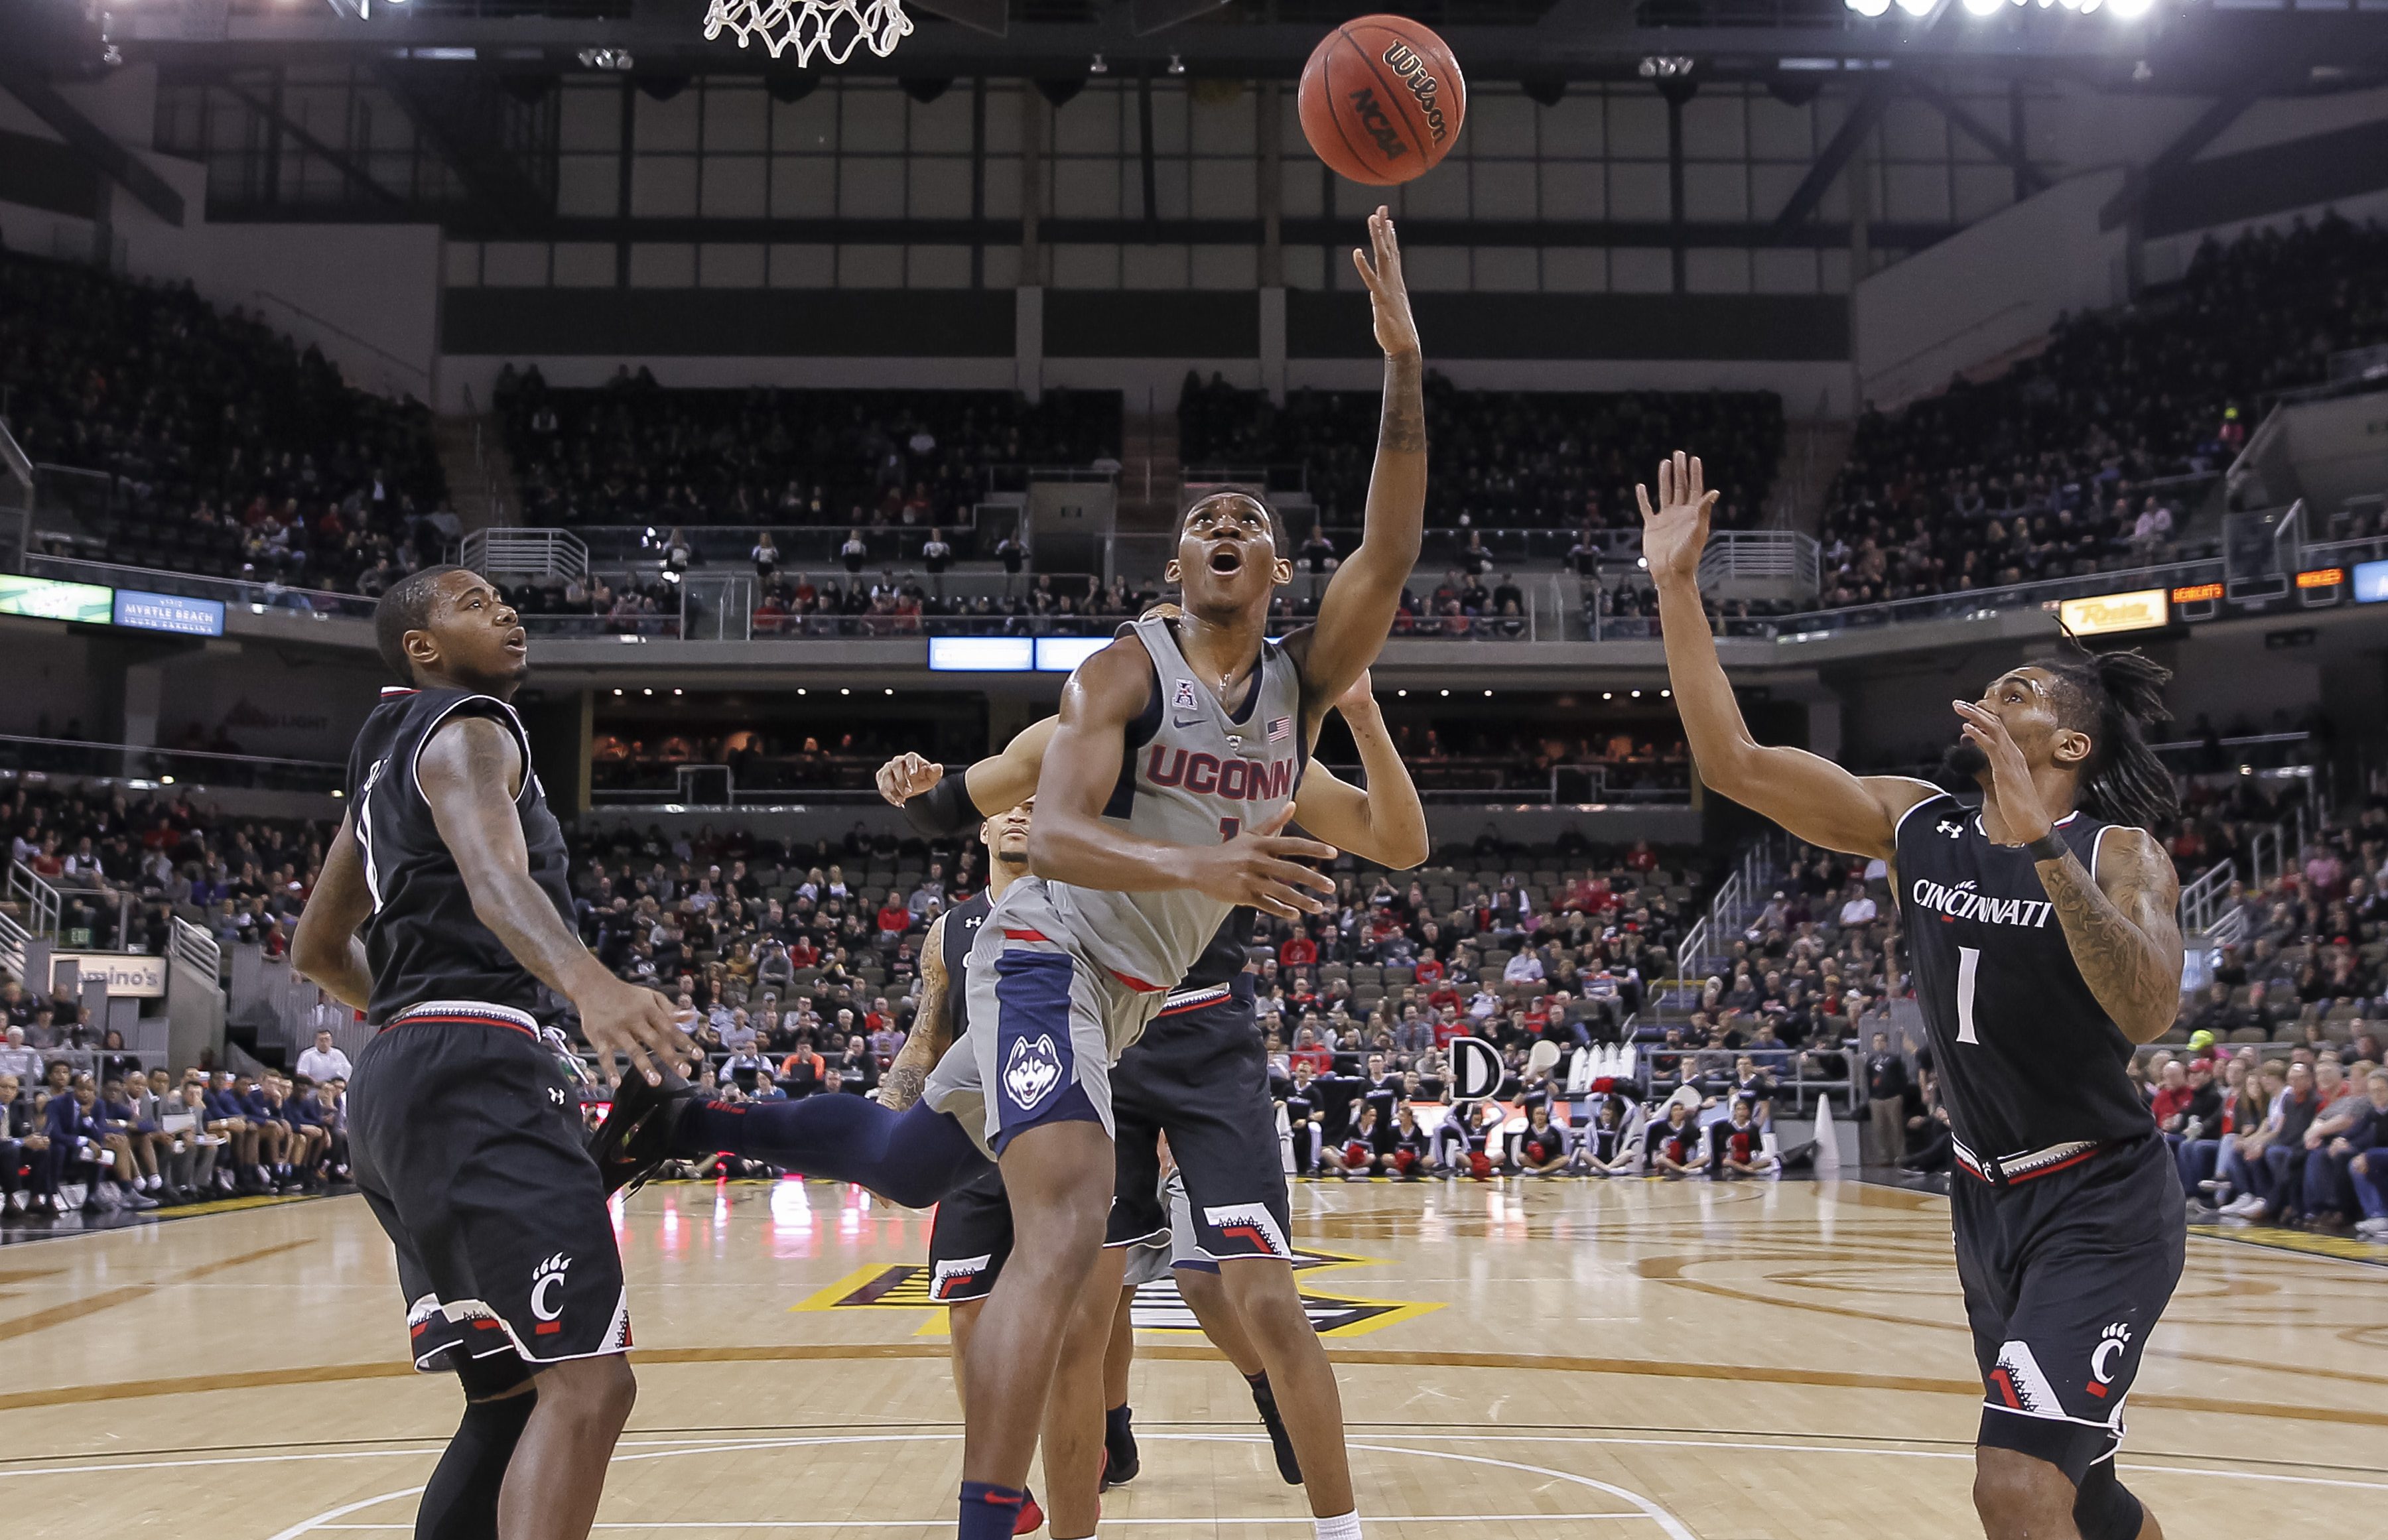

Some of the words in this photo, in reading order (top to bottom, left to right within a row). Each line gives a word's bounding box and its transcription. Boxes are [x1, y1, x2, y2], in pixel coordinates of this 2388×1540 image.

[1382, 38, 1447, 149] Wilson
[1350, 88, 1409, 161] NCAA
[125, 604, 172, 617] MYRTLE
[176, 610, 213, 622] BEACH
[1146, 743, 1294, 801] UCONN
[1913, 879, 2052, 928] CINCINNATI
[78, 964, 159, 986] mino's
[1956, 946, 1981, 1045] 1
[1449, 1037, 1505, 1101] D
